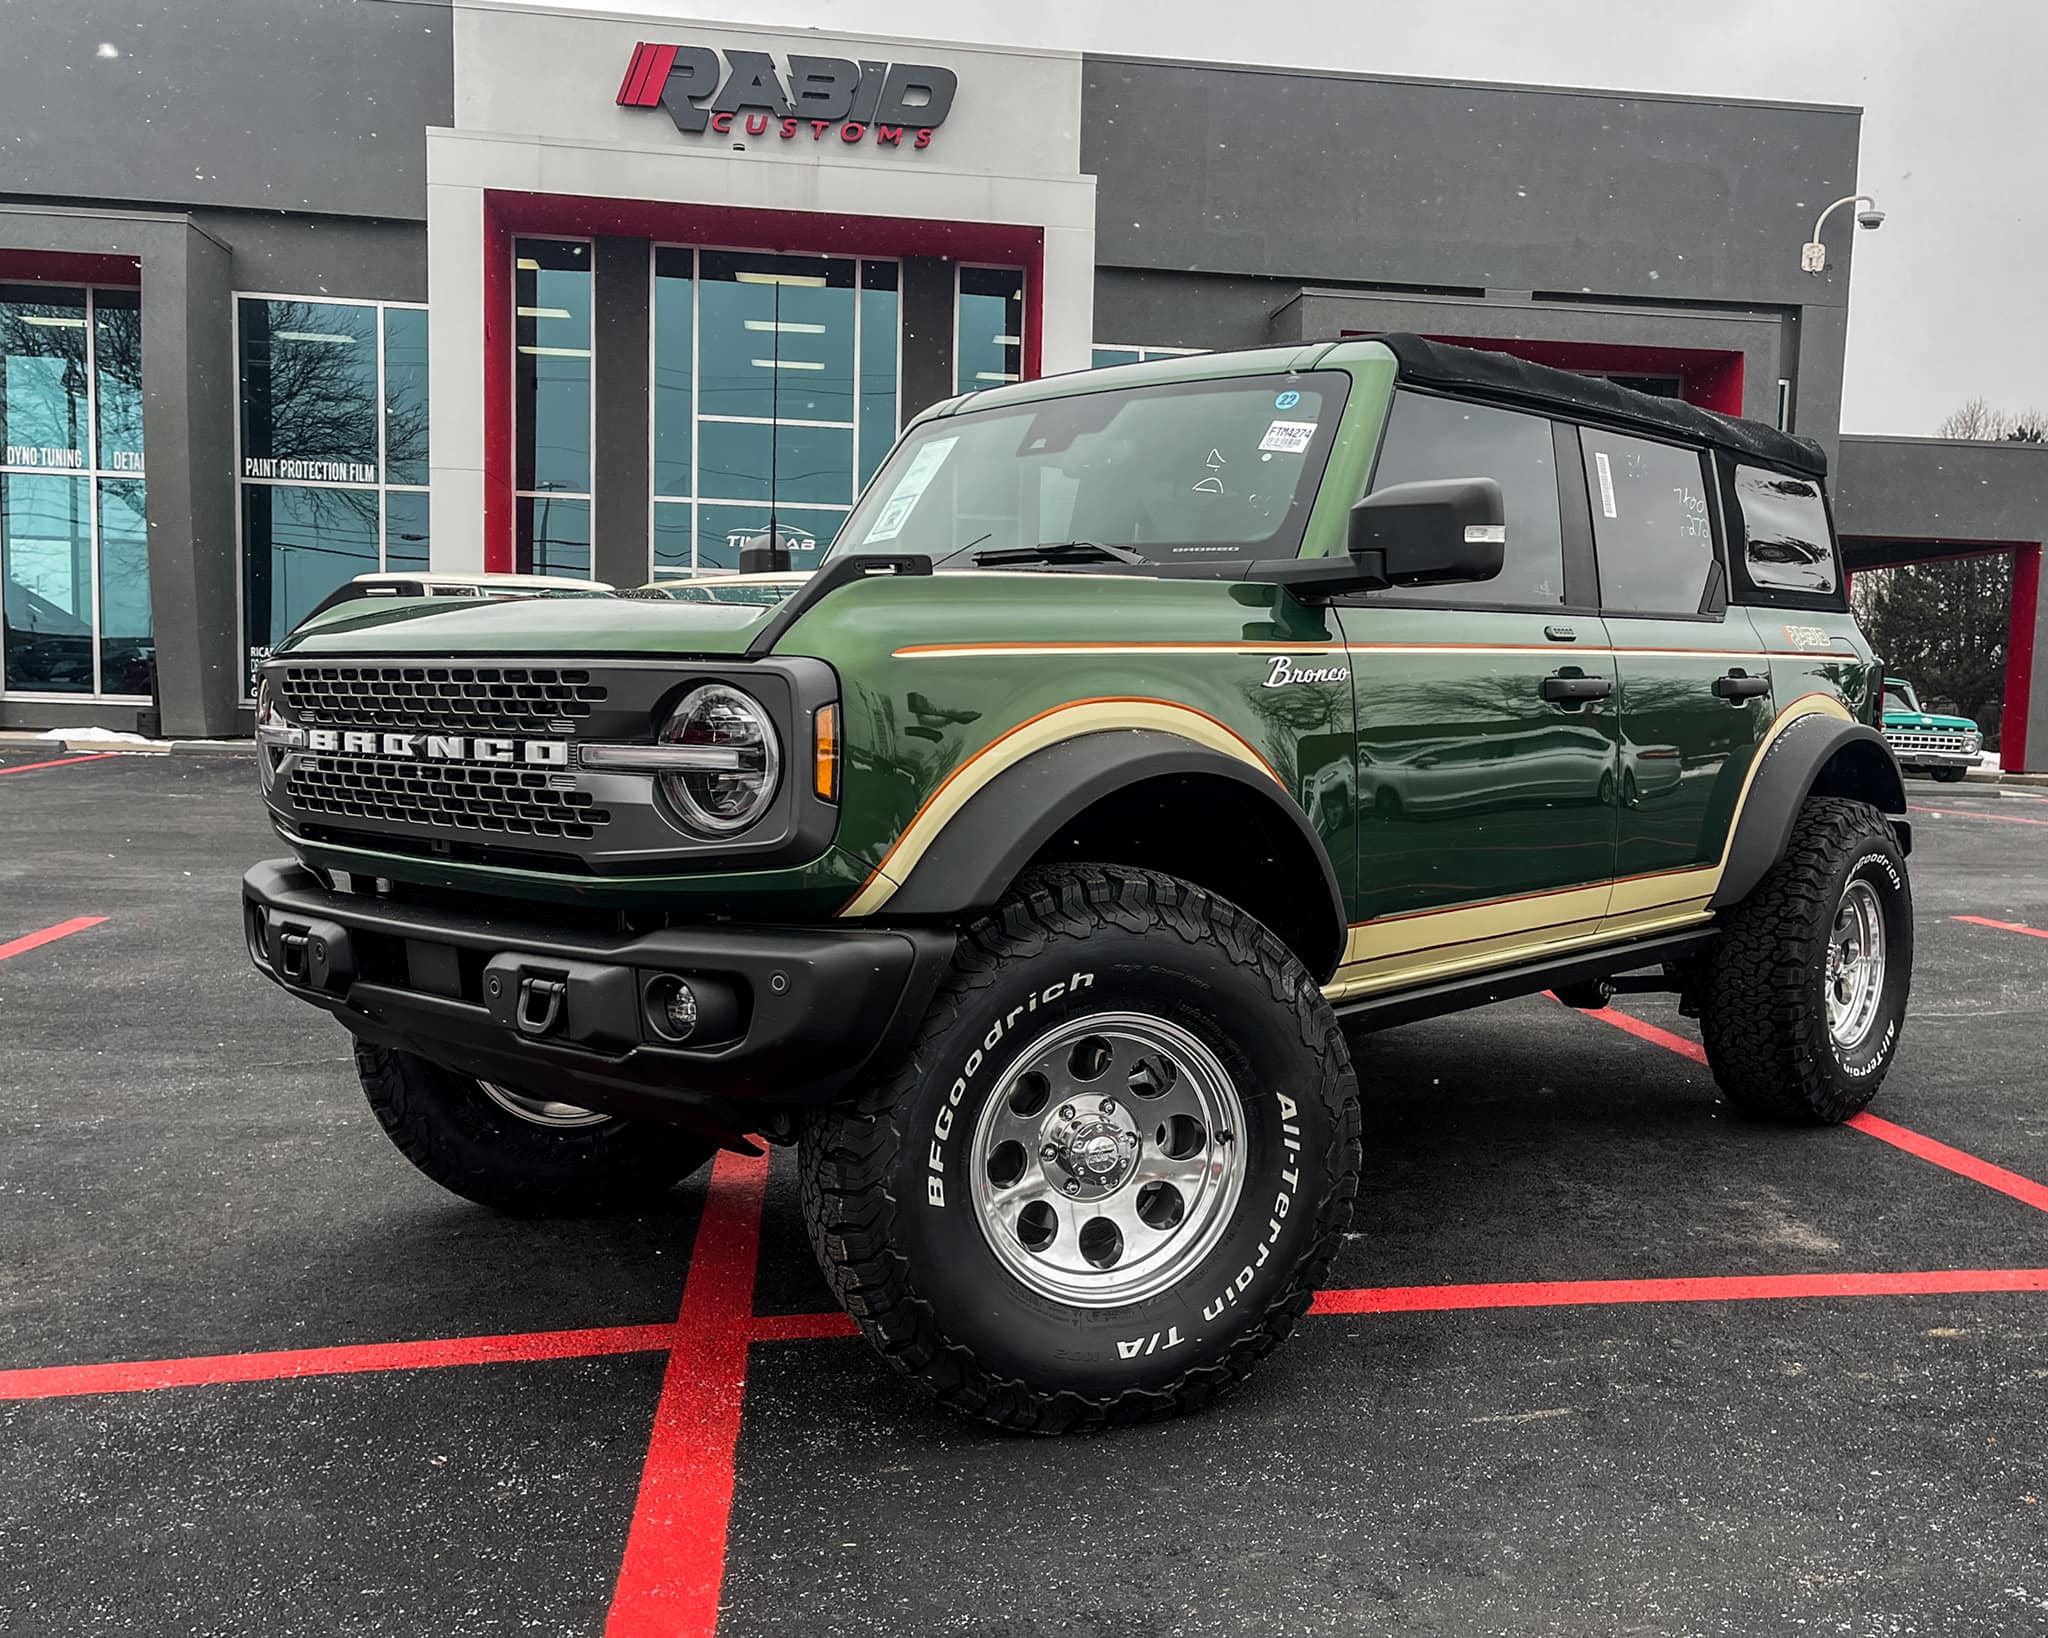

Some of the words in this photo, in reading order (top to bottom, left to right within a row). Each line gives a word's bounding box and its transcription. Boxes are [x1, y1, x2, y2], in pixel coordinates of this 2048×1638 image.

[615, 41, 958, 132] RABID
[712, 112, 932, 149] CUSTOMS
[1278, 394, 1297, 406] 22
[1268, 426, 1312, 439] FTM4274
[7, 446, 37, 465] DYNO
[40, 447, 82, 468] TUNING
[245, 458, 278, 478] PAINT
[280, 459, 347, 481] PROTECTION
[349, 463, 375, 482] FILM
[1262, 656, 1351, 688] Bronco
[308, 729, 569, 764] BRONCO
[928, 972, 1095, 1208] BFGoodrich
[1202, 1091, 1302, 1321] All-Terrain
[1116, 1326, 1185, 1360] T/A
